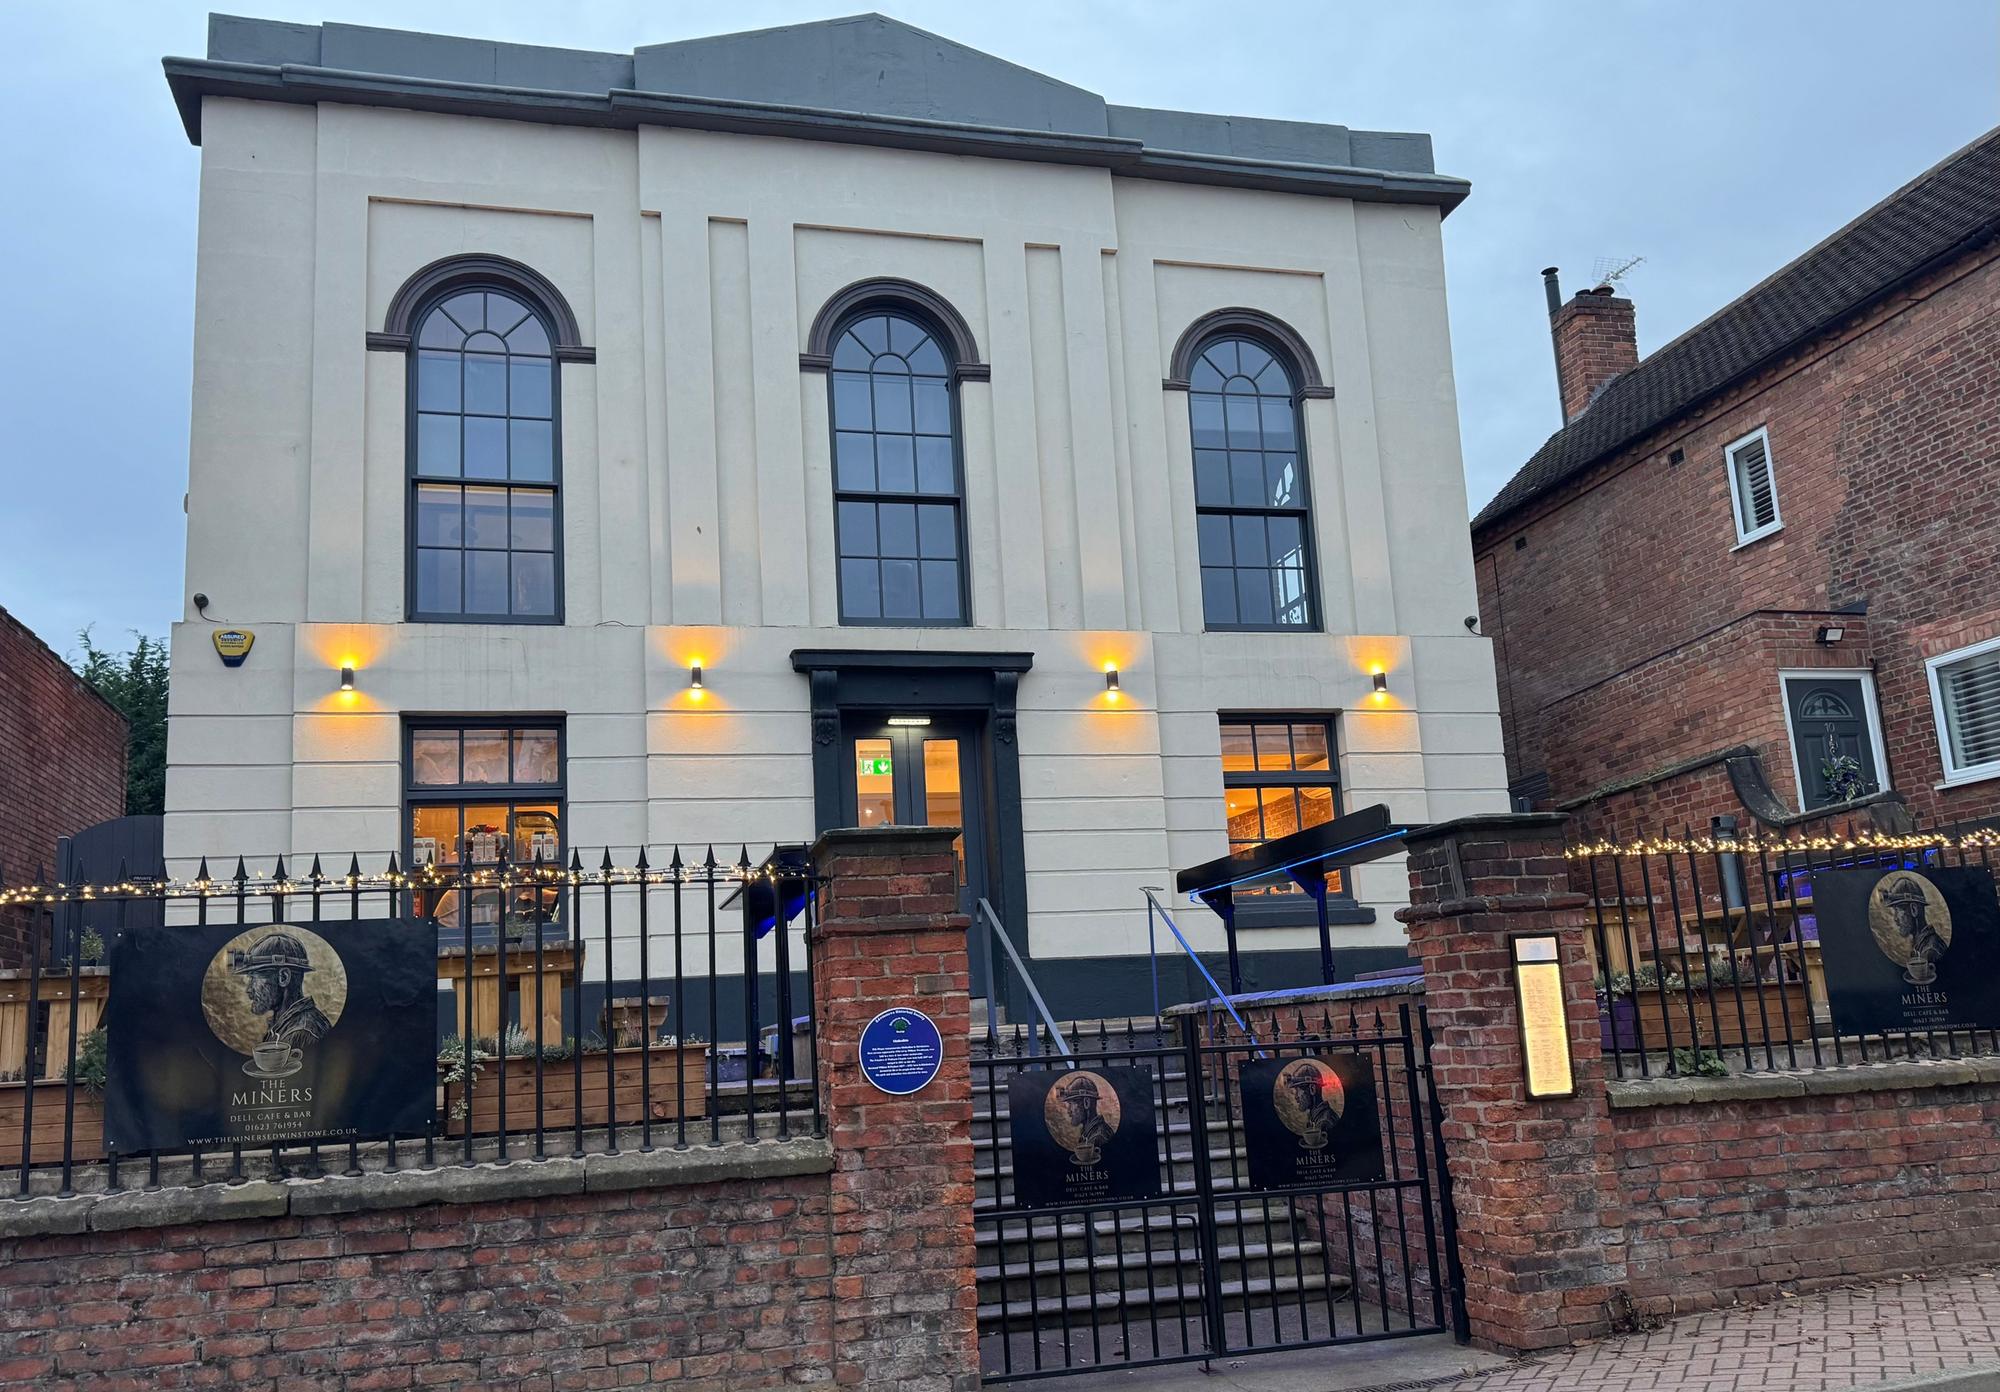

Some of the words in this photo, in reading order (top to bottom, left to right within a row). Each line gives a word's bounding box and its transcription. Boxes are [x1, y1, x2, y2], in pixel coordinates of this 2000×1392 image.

[1824, 722, 1835, 732] 10
[1915, 985, 1930, 993] THE
[1901, 991, 1949, 1005] MINERS
[260, 1080, 286, 1089] THE
[231, 1088, 313, 1106] MINERS
[230, 1114, 254, 1122] DELI,
[257, 1112, 281, 1120] CAFE
[245, 1123, 270, 1131] 01623
[273, 1121, 303, 1129] 761954
[187, 1128, 358, 1145] WWW.THEMINERSEDWINSTOWE.CO.UK
[1296, 1154, 1336, 1166] MINERS
[1066, 1170, 1109, 1183] MINERS
